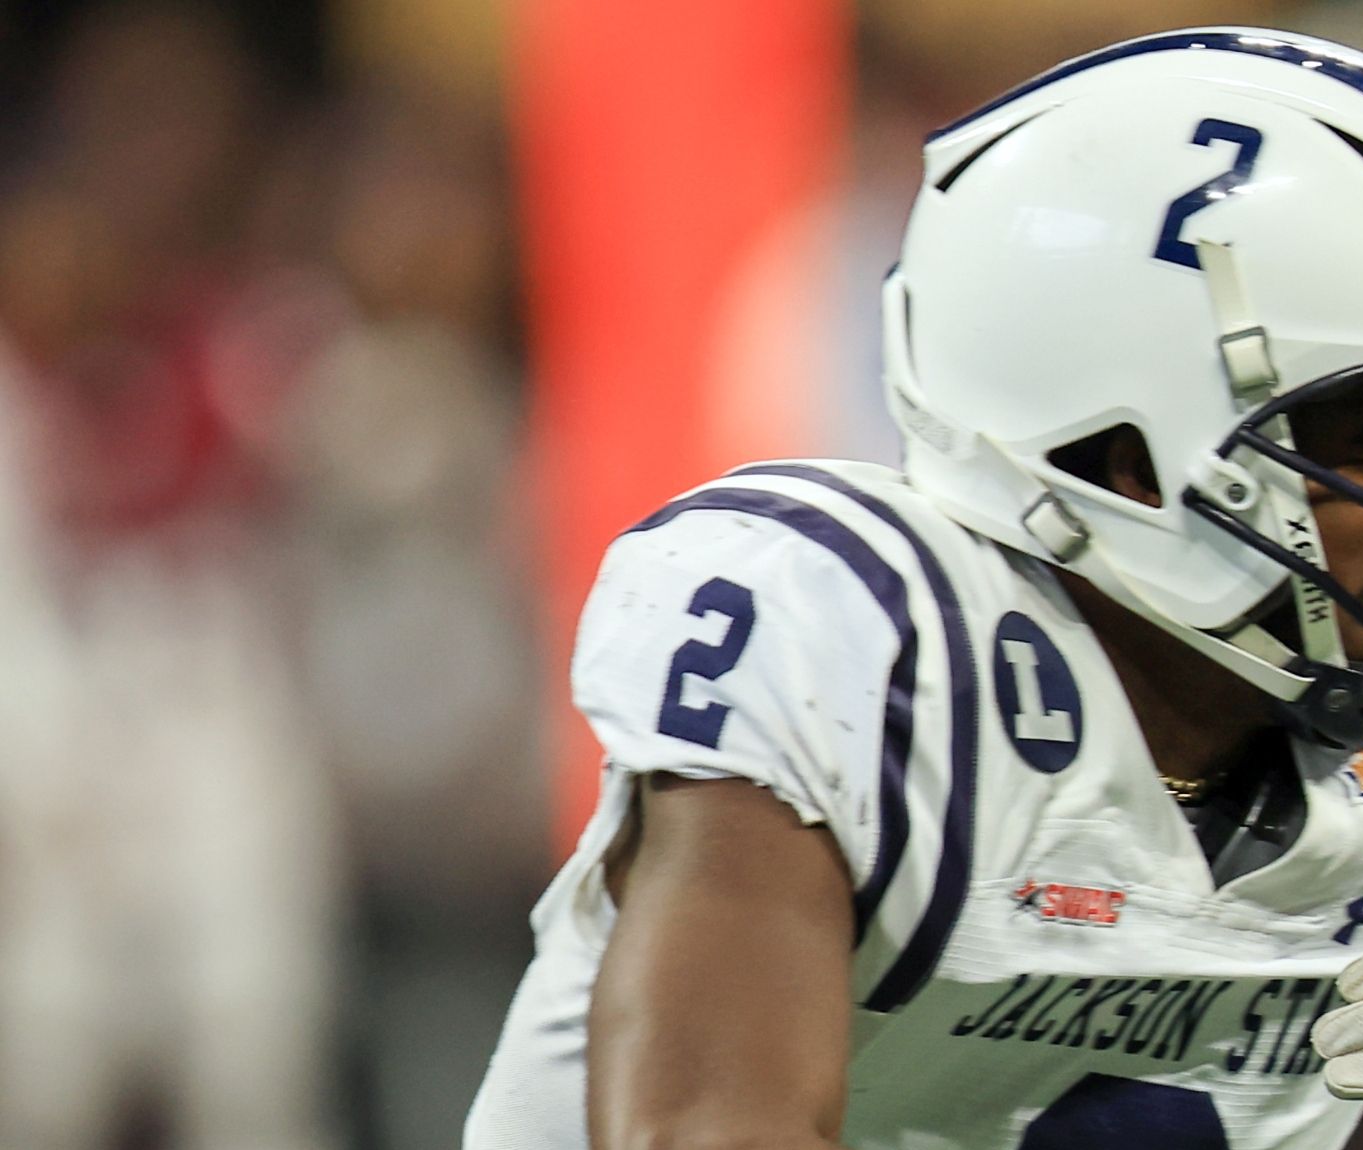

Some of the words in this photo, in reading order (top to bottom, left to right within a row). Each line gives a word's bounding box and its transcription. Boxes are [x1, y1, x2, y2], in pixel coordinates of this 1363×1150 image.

[1153, 118, 1263, 270] 2
[657, 576, 756, 749] 2
[1003, 638, 1075, 743] L
[951, 973, 1236, 1063] JACKSON
[1225, 977, 1340, 1075] STA
